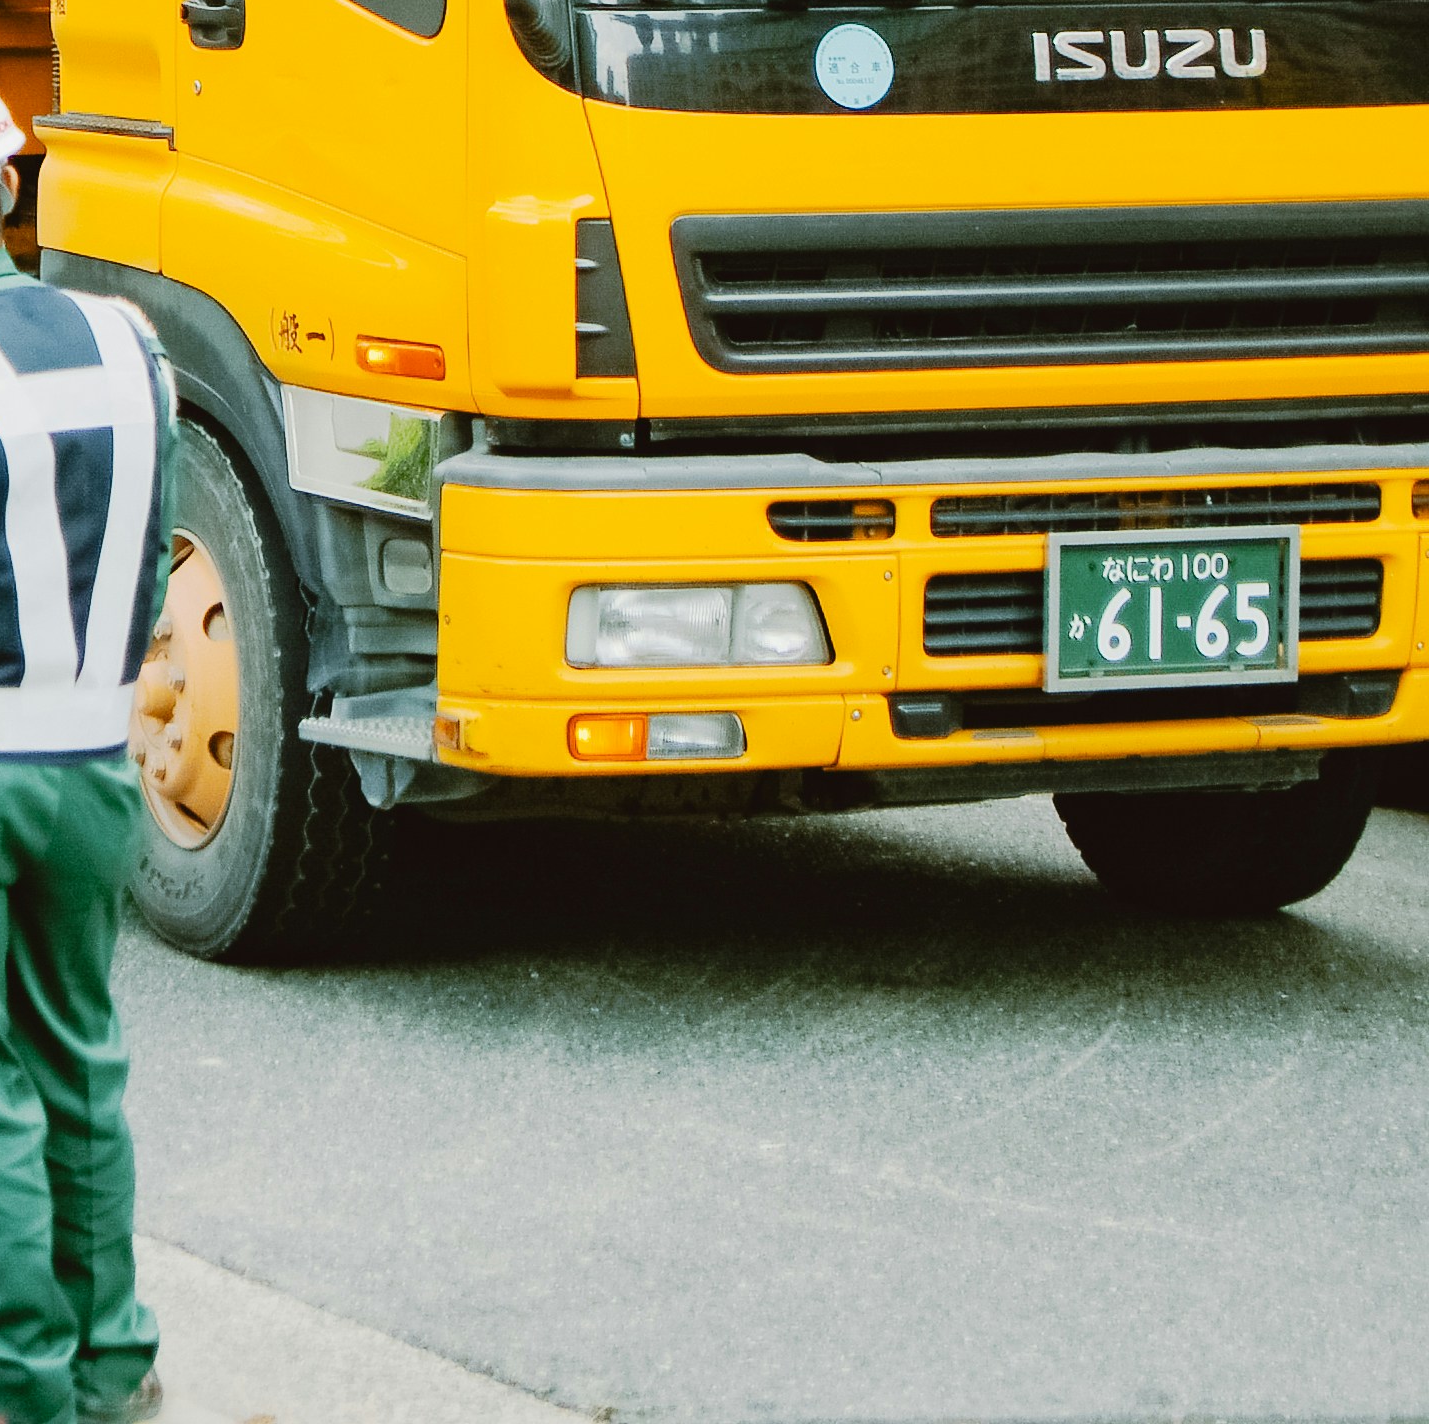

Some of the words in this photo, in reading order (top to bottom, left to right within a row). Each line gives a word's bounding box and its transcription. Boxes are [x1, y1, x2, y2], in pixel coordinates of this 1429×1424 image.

[1033, 29, 1267, 81] ISUZU
[1068, 612, 1092, 641] か
[1097, 582, 1271, 662] 61-65
